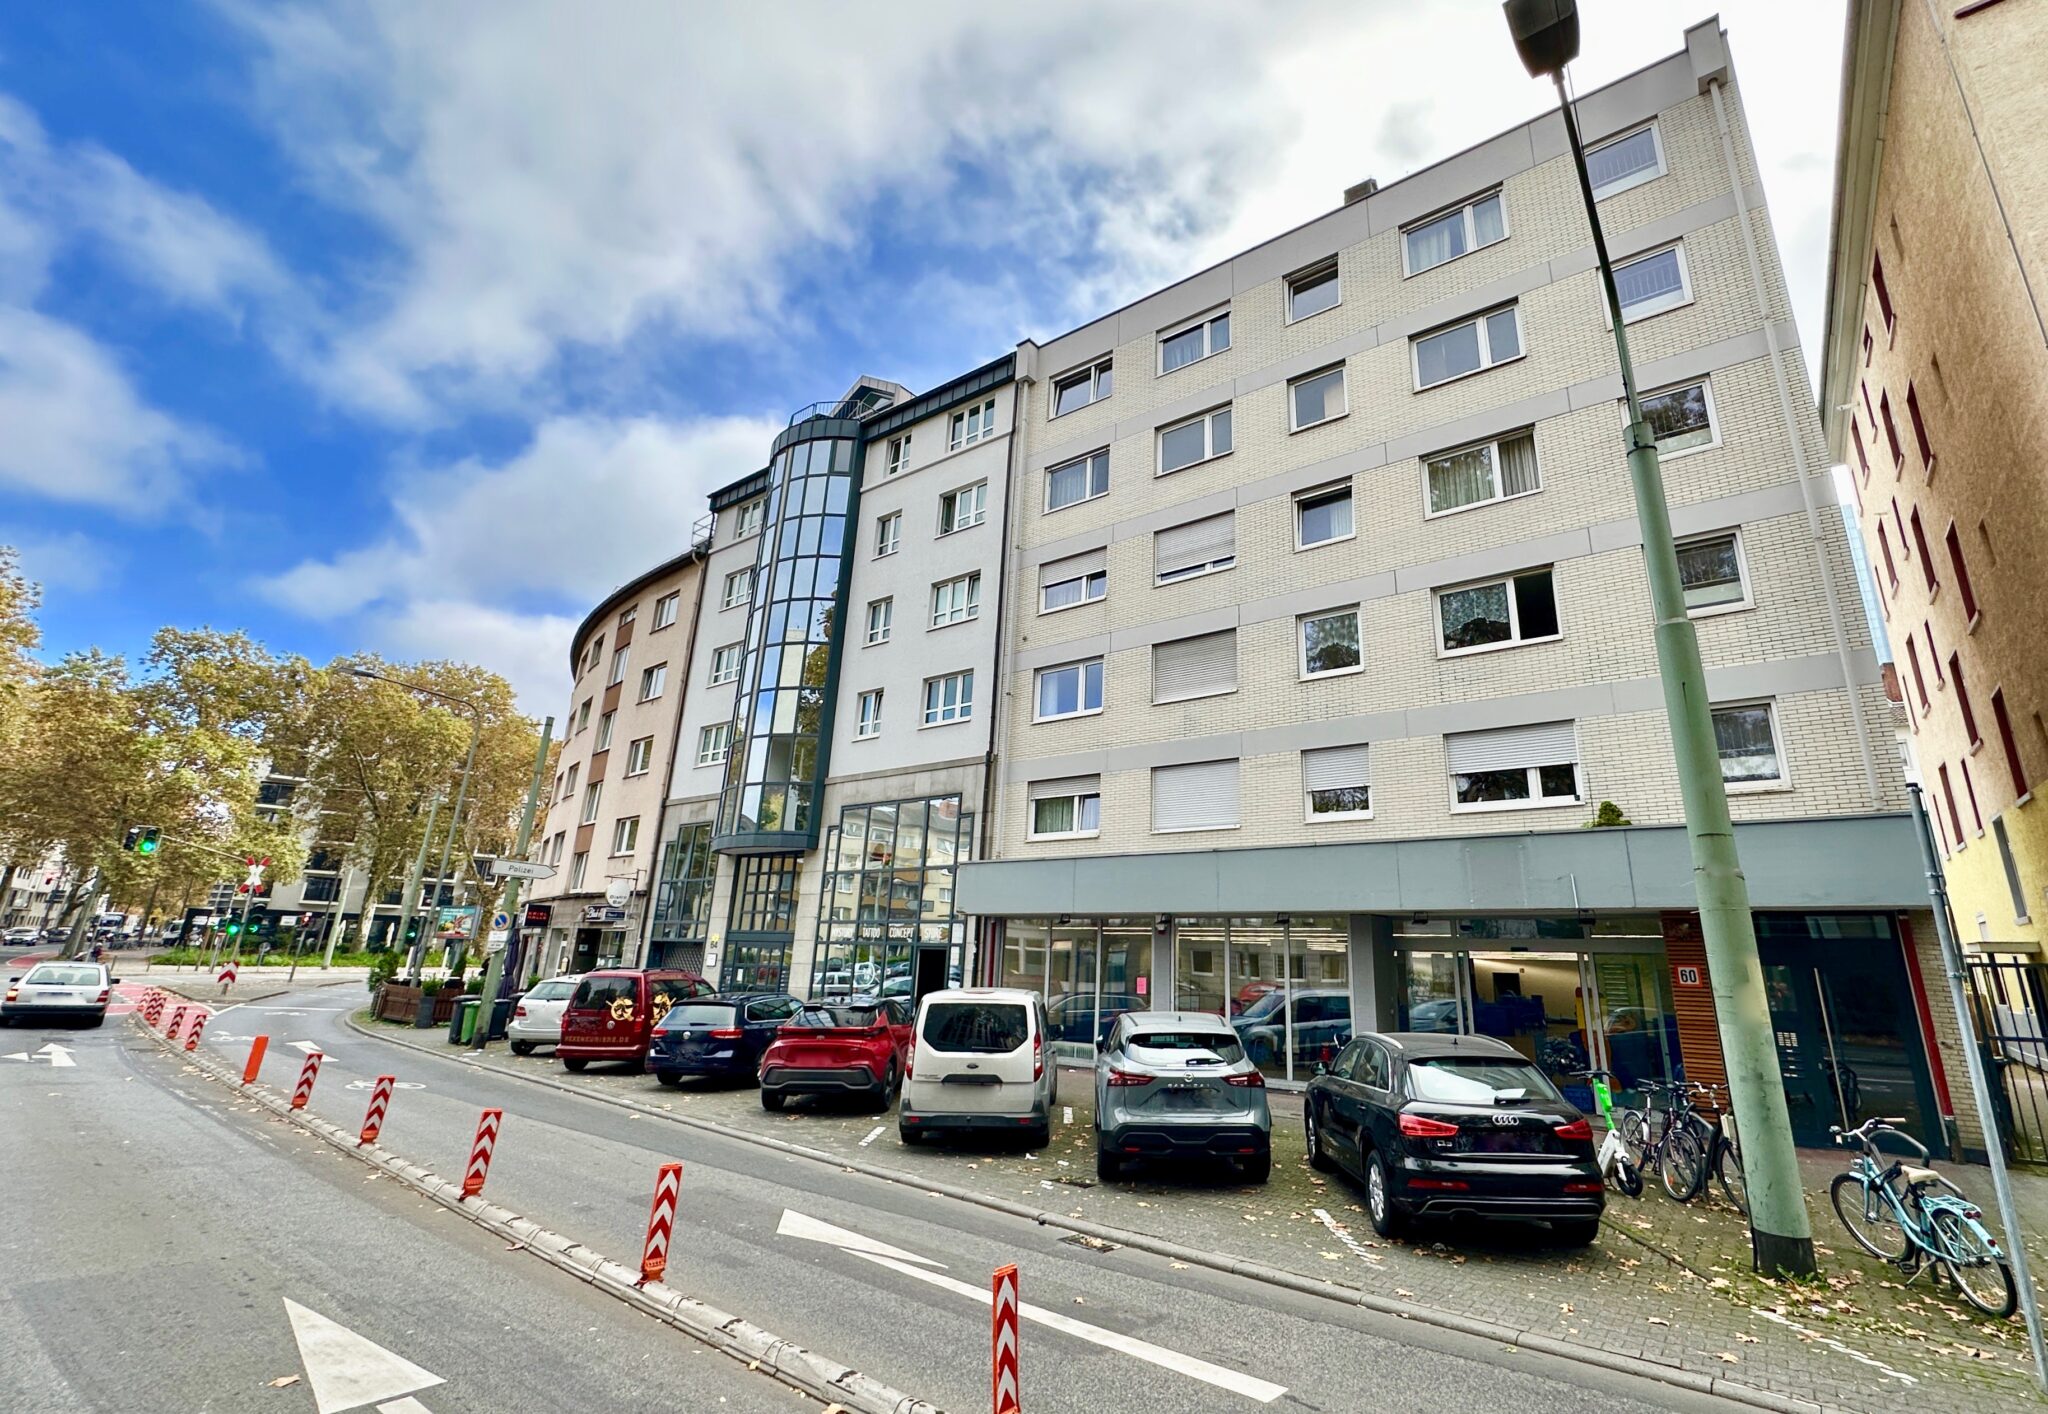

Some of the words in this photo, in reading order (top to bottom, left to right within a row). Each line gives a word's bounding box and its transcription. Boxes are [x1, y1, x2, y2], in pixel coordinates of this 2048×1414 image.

[508, 865, 534, 874] Polizei
[862, 927, 880, 938] TATTOO
[889, 927, 914, 938] CONCEPT
[924, 927, 943, 938] STORE
[1680, 969, 1697, 983] 60
